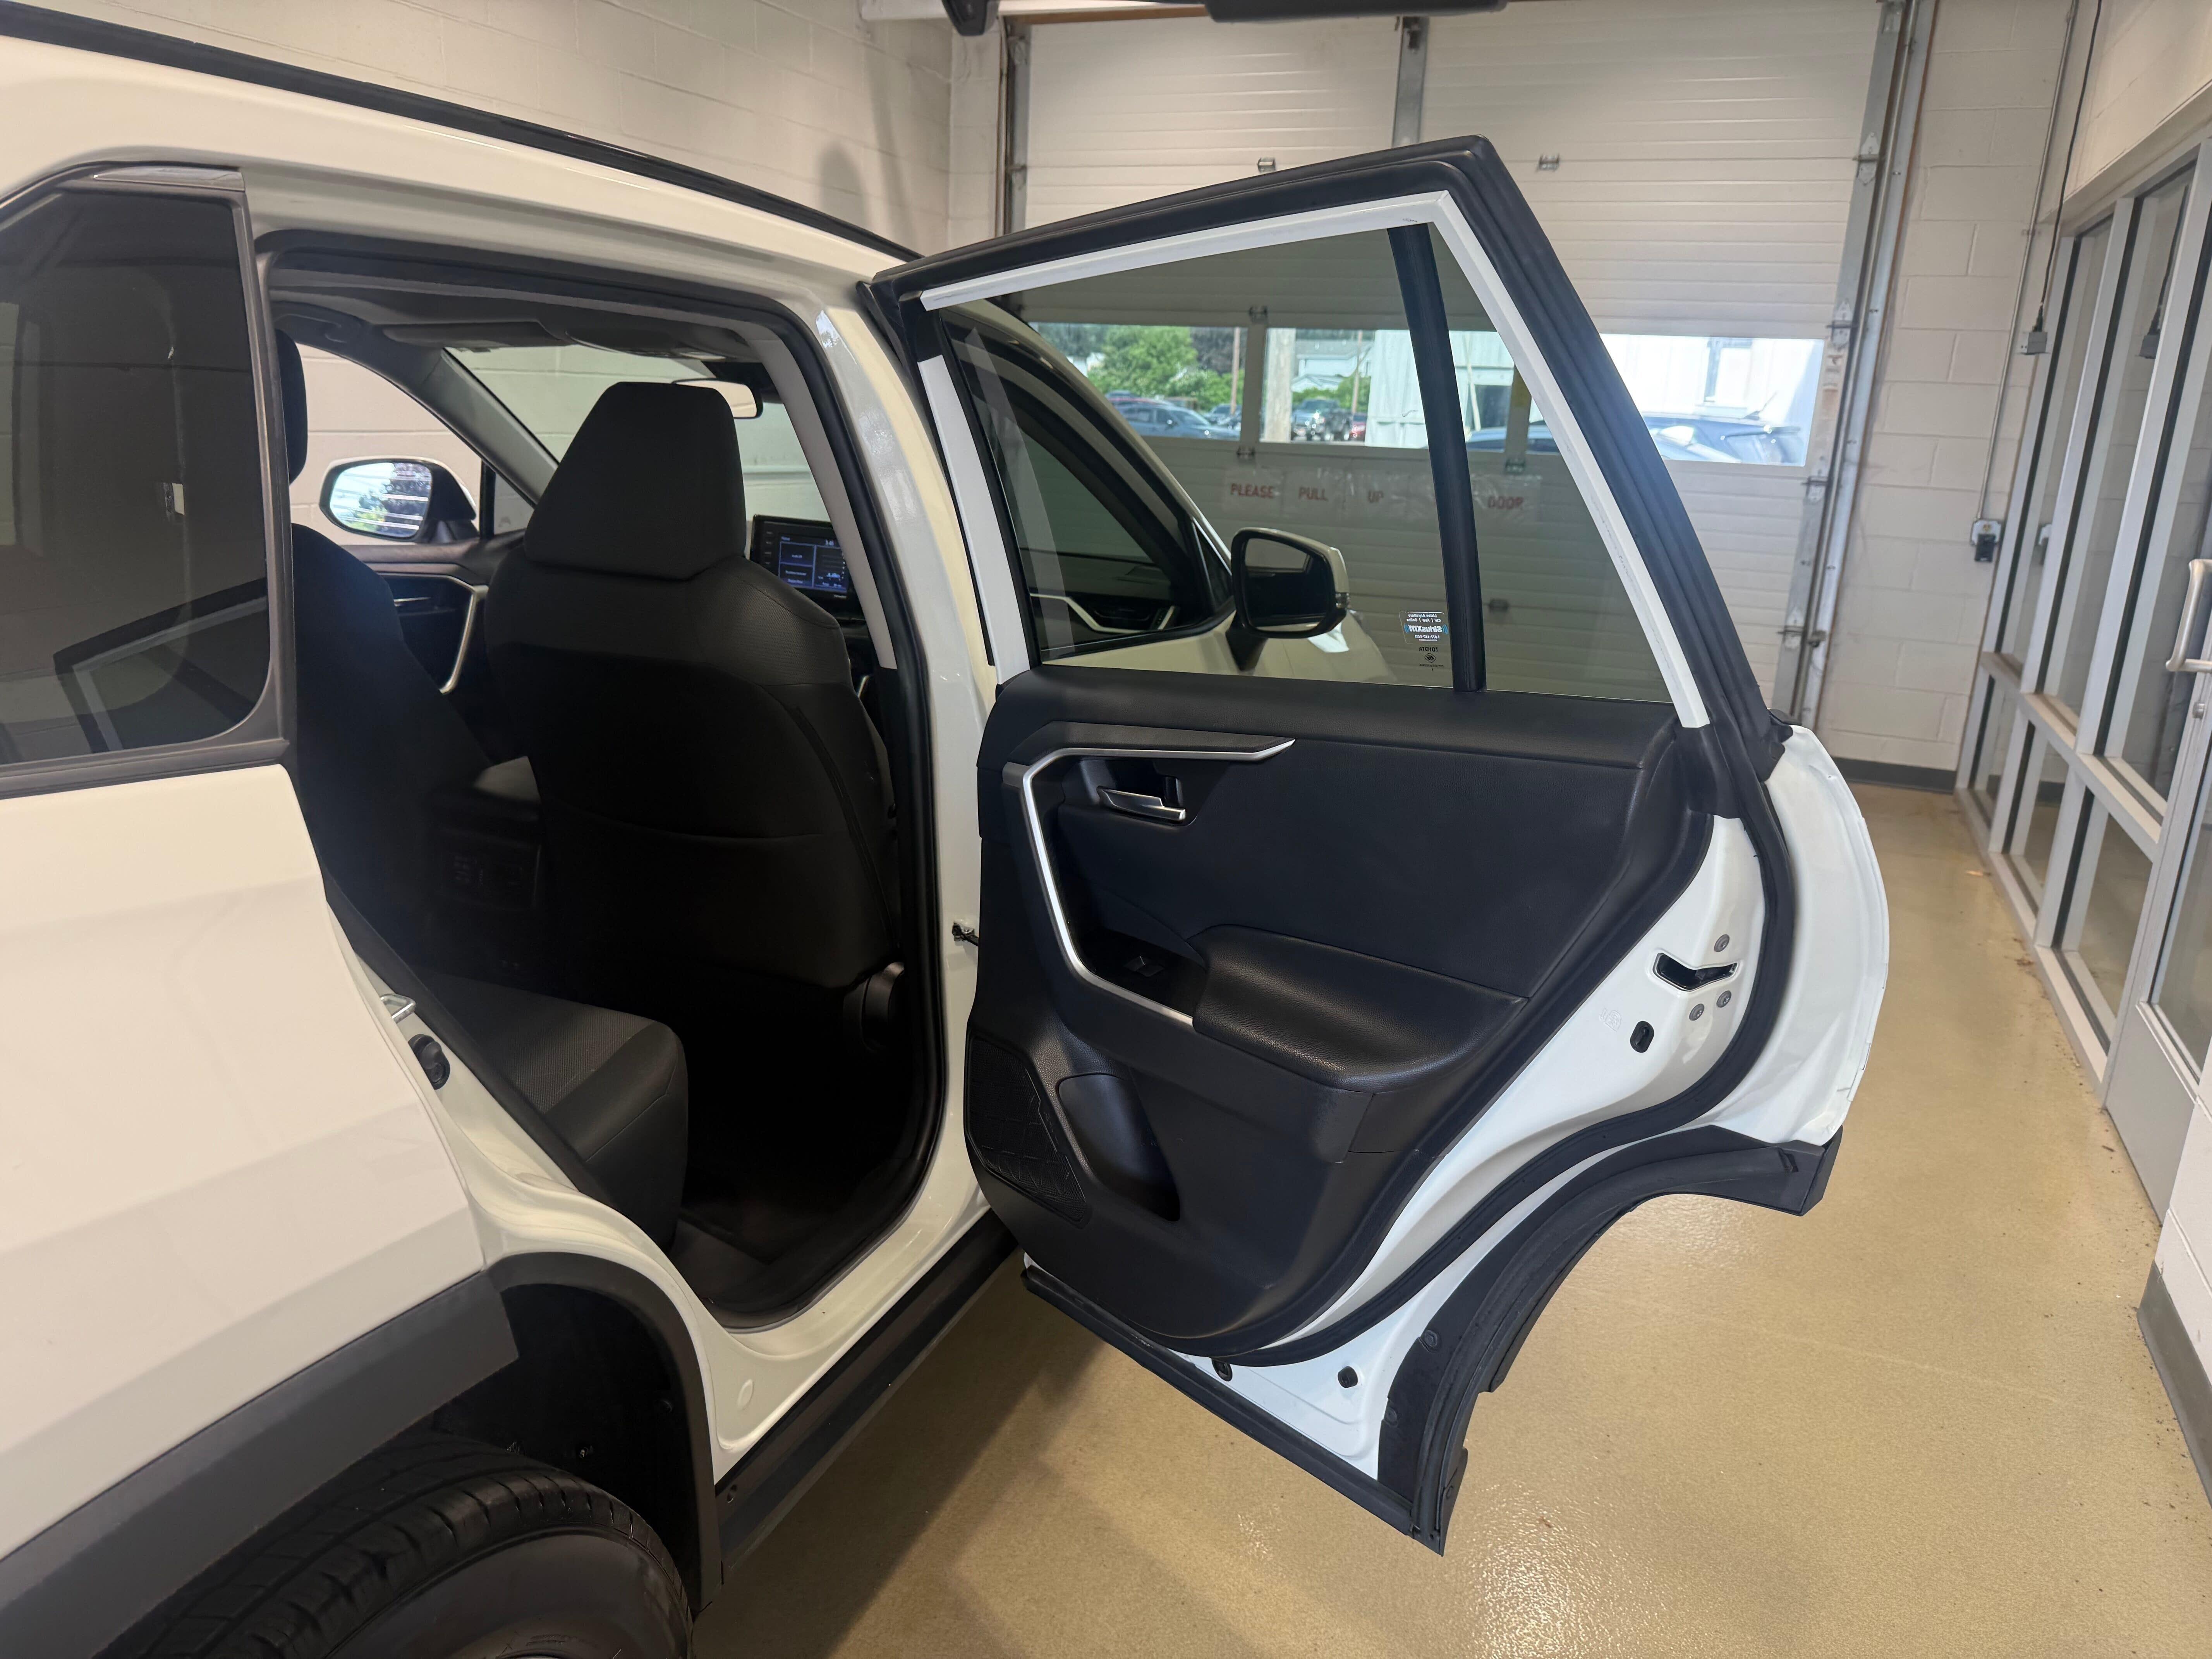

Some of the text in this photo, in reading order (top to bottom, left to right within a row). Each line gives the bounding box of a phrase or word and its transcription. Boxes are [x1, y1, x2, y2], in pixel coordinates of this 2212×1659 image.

[1231, 483, 1275, 498] PLEASE
[1298, 486, 1328, 501] PULL
[1367, 489, 1384, 503] UP
